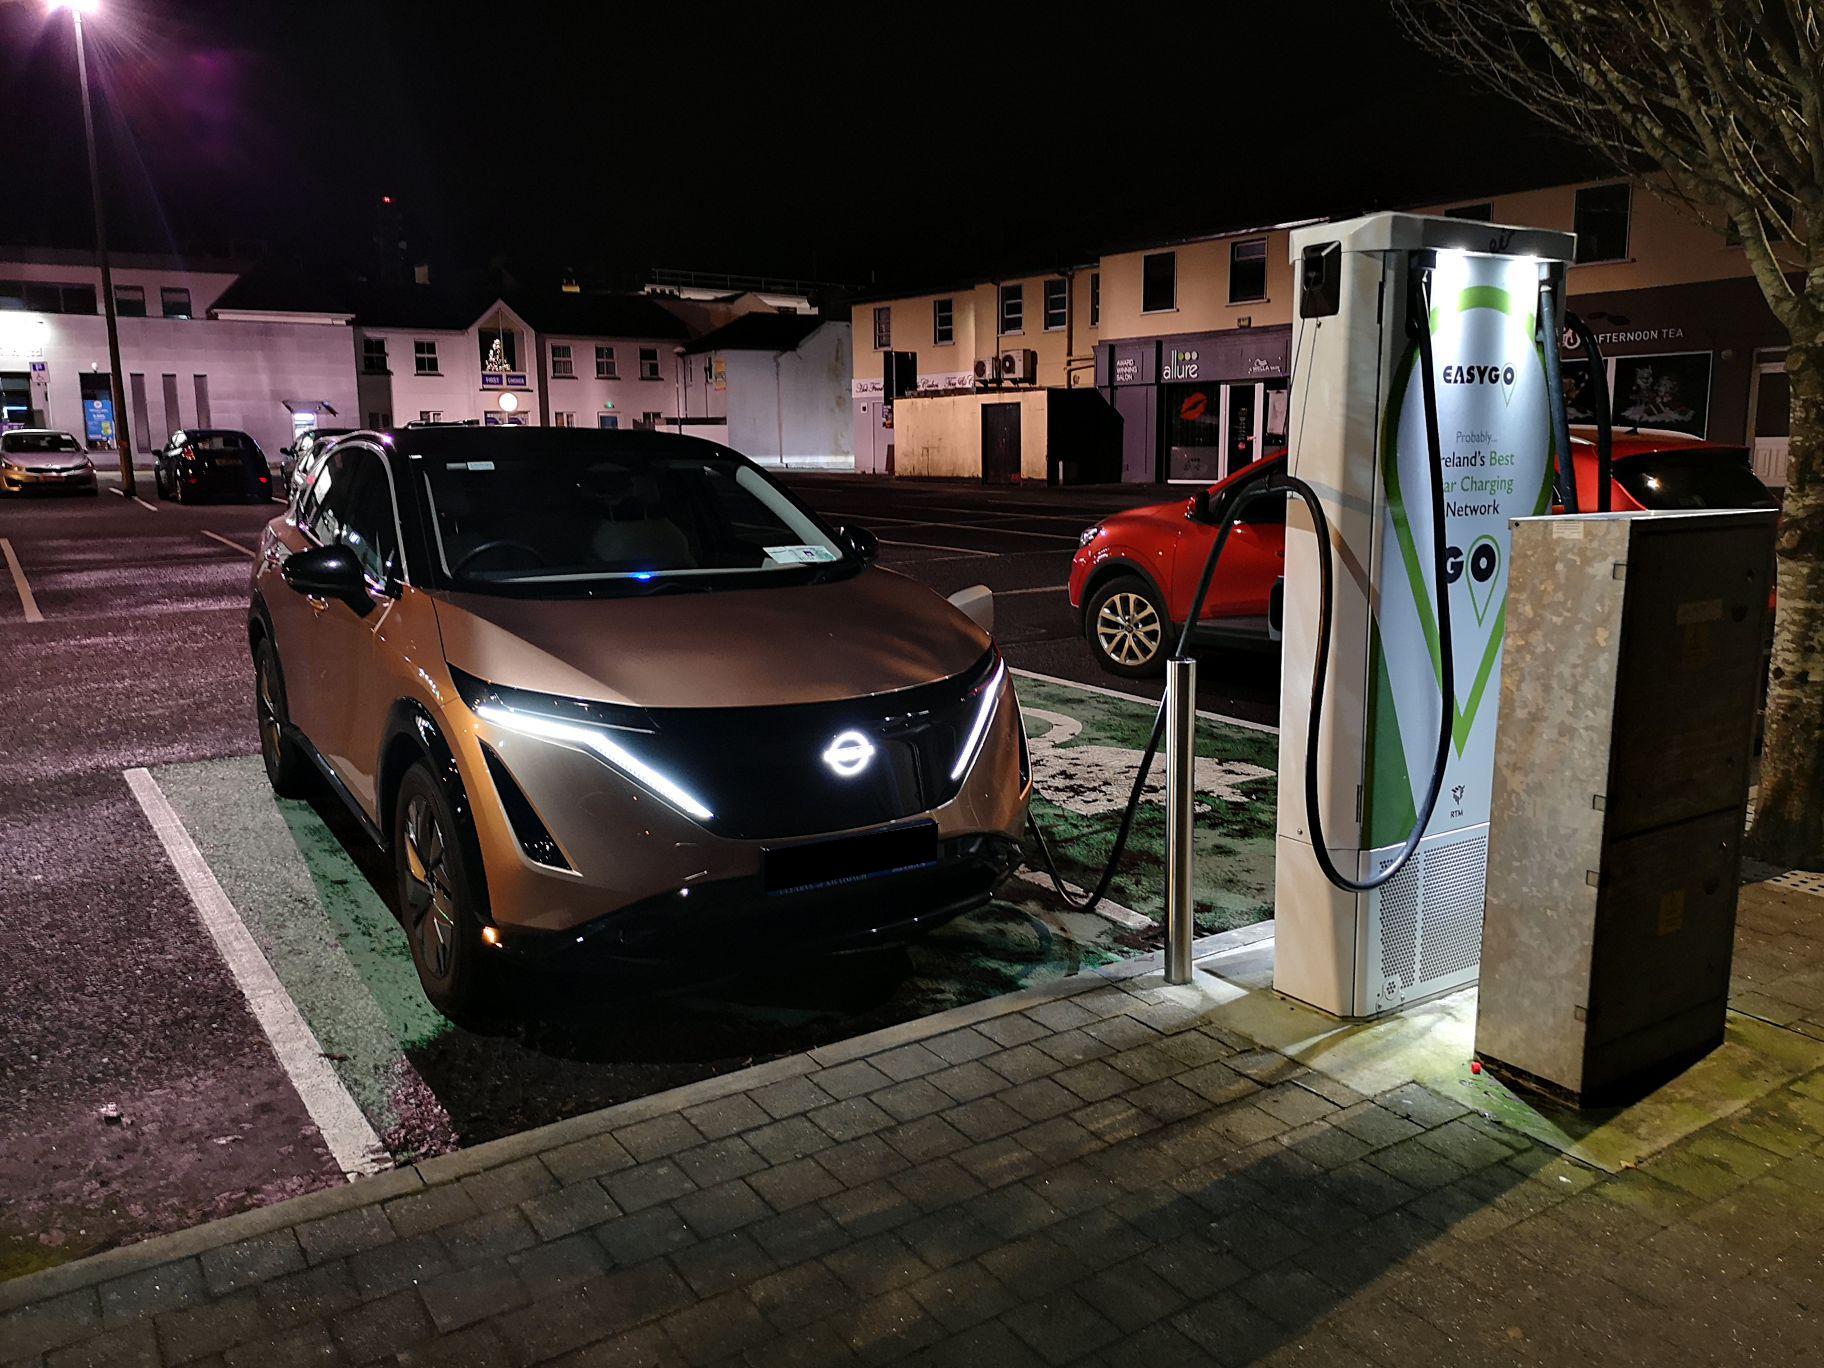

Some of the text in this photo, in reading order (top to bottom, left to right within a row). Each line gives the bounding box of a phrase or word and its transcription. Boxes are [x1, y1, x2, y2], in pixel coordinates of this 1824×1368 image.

[1662, 328, 1685, 339] TEA
[1163, 350, 1199, 379] allure
[1442, 365, 1515, 386] EASYGO
[1489, 450, 1515, 466] Best
[1443, 475, 1514, 496] ar Charging
[1446, 499, 1500, 518] Network
[1445, 543, 1497, 584] GO
